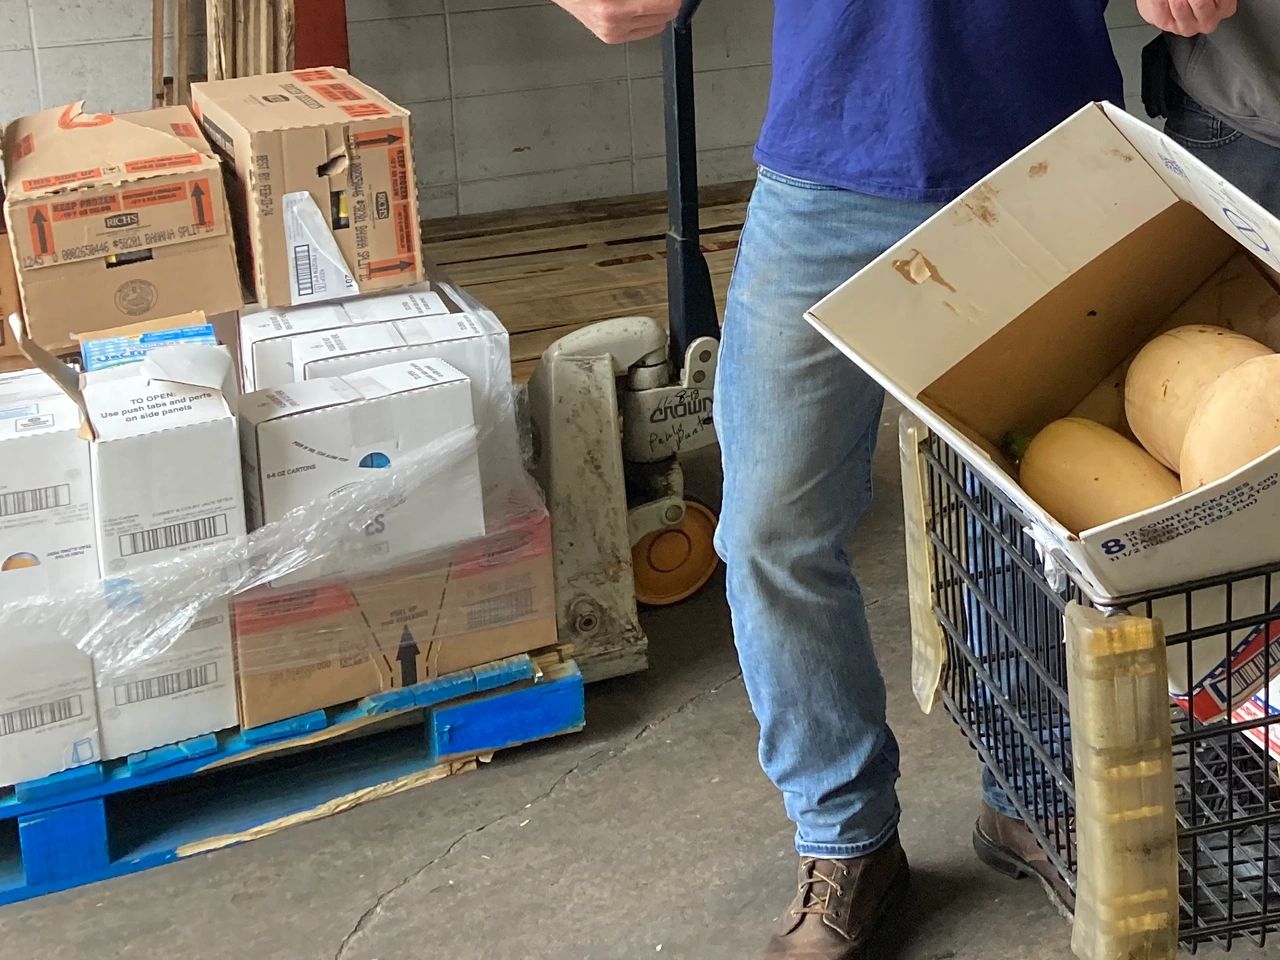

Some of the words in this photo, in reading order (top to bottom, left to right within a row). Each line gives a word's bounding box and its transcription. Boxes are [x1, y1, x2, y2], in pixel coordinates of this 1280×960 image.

[256, 155, 269, 172] BEST
[396, 149, 405, 170] KEEP
[398, 171, 408, 200] FROZEN
[53, 201, 77, 212] KEEP
[80, 195, 117, 208] FROZEN
[145, 231, 176, 245] BANANA
[178, 224, 202, 238] SPLIT
[100, 409, 119, 419] Use
[121, 405, 145, 417] push
[147, 400, 167, 411] tabs
[169, 397, 186, 407] and
[130, 397, 144, 405] TO
[140, 411, 160, 421] side
[162, 405, 192, 418] panels
[1177, 502, 1223, 524] PLATES
[1226, 486, 1255, 505] (29.2
[1257, 472, 1279, 487] cm)
[1123, 530, 1137, 538] 12
[1139, 513, 1181, 532] COUNT
[1184, 481, 1250, 514] PACKAGES
[1132, 519, 1197, 548] PAQUETES
[1199, 512, 1215, 522] DE
[1216, 505, 1230, 514] 12
[1232, 480, 1279, 507] PLATOS
[1122, 547, 1142, 558] 1/2
[1143, 524, 1202, 549] PULGADA
[1236, 498, 1258, 512] cm)
[1101, 538, 1126, 555] 8
